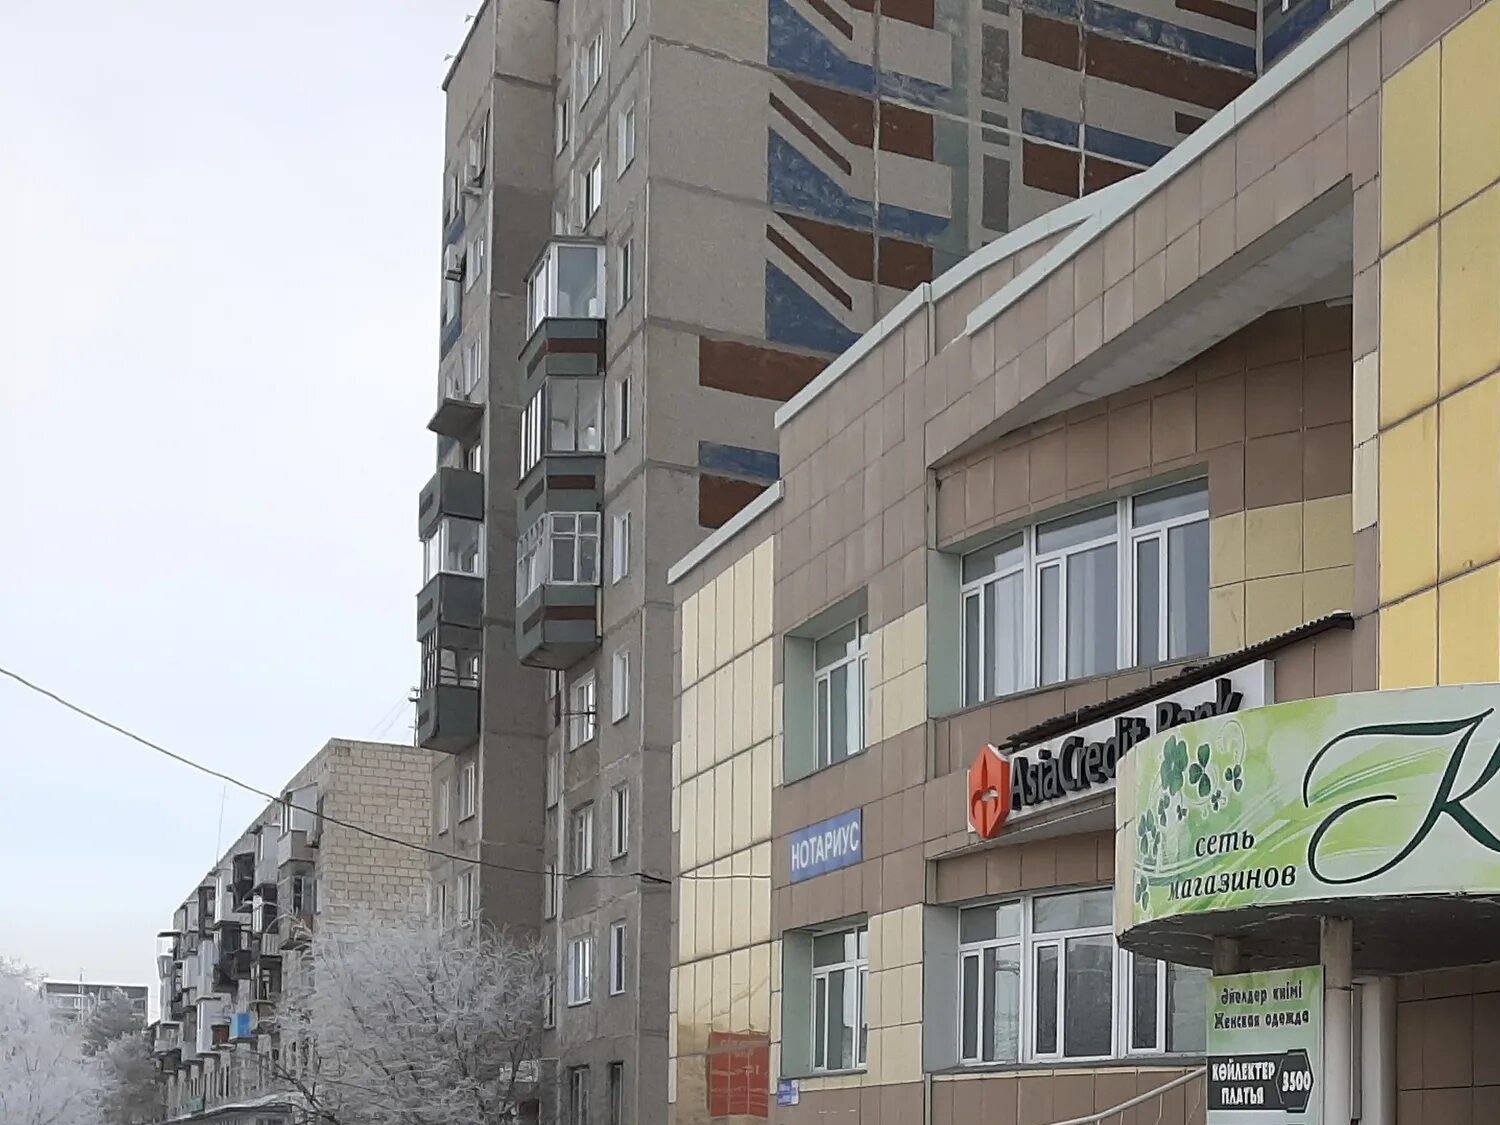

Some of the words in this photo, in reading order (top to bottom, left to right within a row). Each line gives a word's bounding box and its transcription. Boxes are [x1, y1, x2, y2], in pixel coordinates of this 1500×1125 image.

[791, 821, 859, 871] НОТАРИУС
[1195, 830, 1255, 858] сеть
[1168, 865, 1297, 901] магазинов
[1213, 1012, 1260, 1030] Женская
[1265, 1010, 1310, 1028] одежда
[1212, 1058, 1276, 1081] КӨЙЛЕКТЕР
[1282, 1070, 1312, 1092] 3500
[1221, 1086, 1265, 1106] ПЛАТЬЯ
